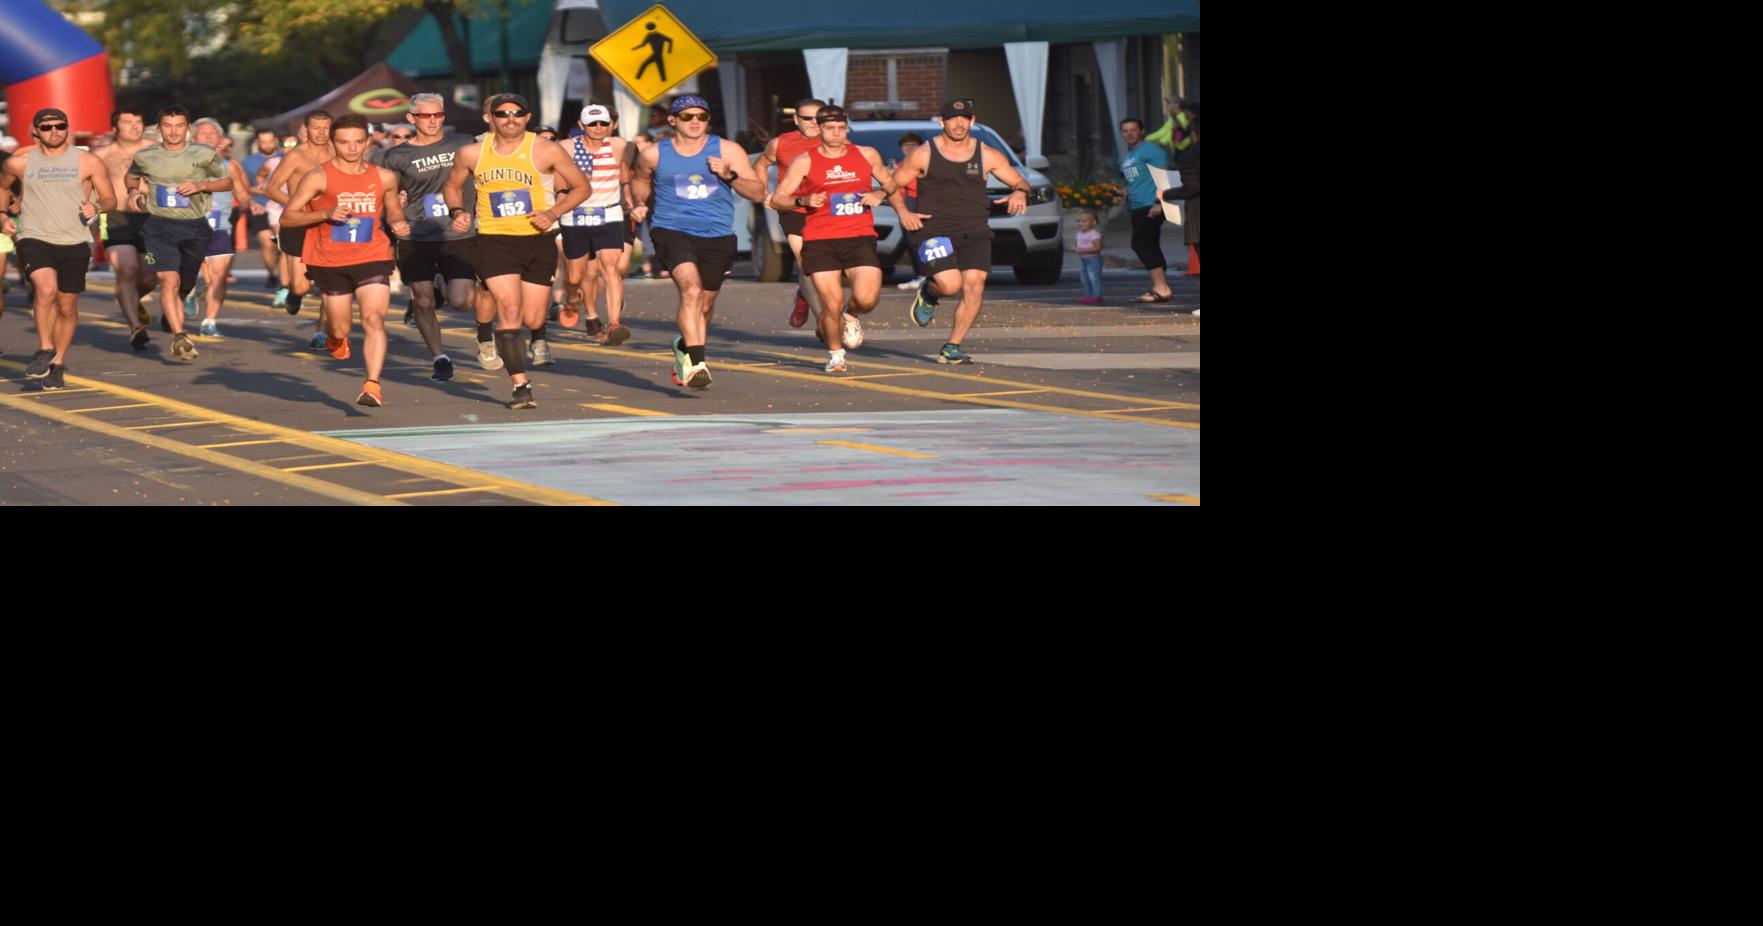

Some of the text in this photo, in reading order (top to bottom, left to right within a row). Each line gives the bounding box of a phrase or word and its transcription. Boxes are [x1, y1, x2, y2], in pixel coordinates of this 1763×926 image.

[411, 152, 456, 169] TIMEX
[477, 168, 533, 186] CLINTON
[687, 184, 709, 200] 24
[167, 195, 177, 207] 5
[497, 200, 526, 218] 152
[431, 203, 450, 217] 31
[577, 214, 602, 227] 305
[348, 228, 358, 243] 1
[925, 245, 948, 262] 211
